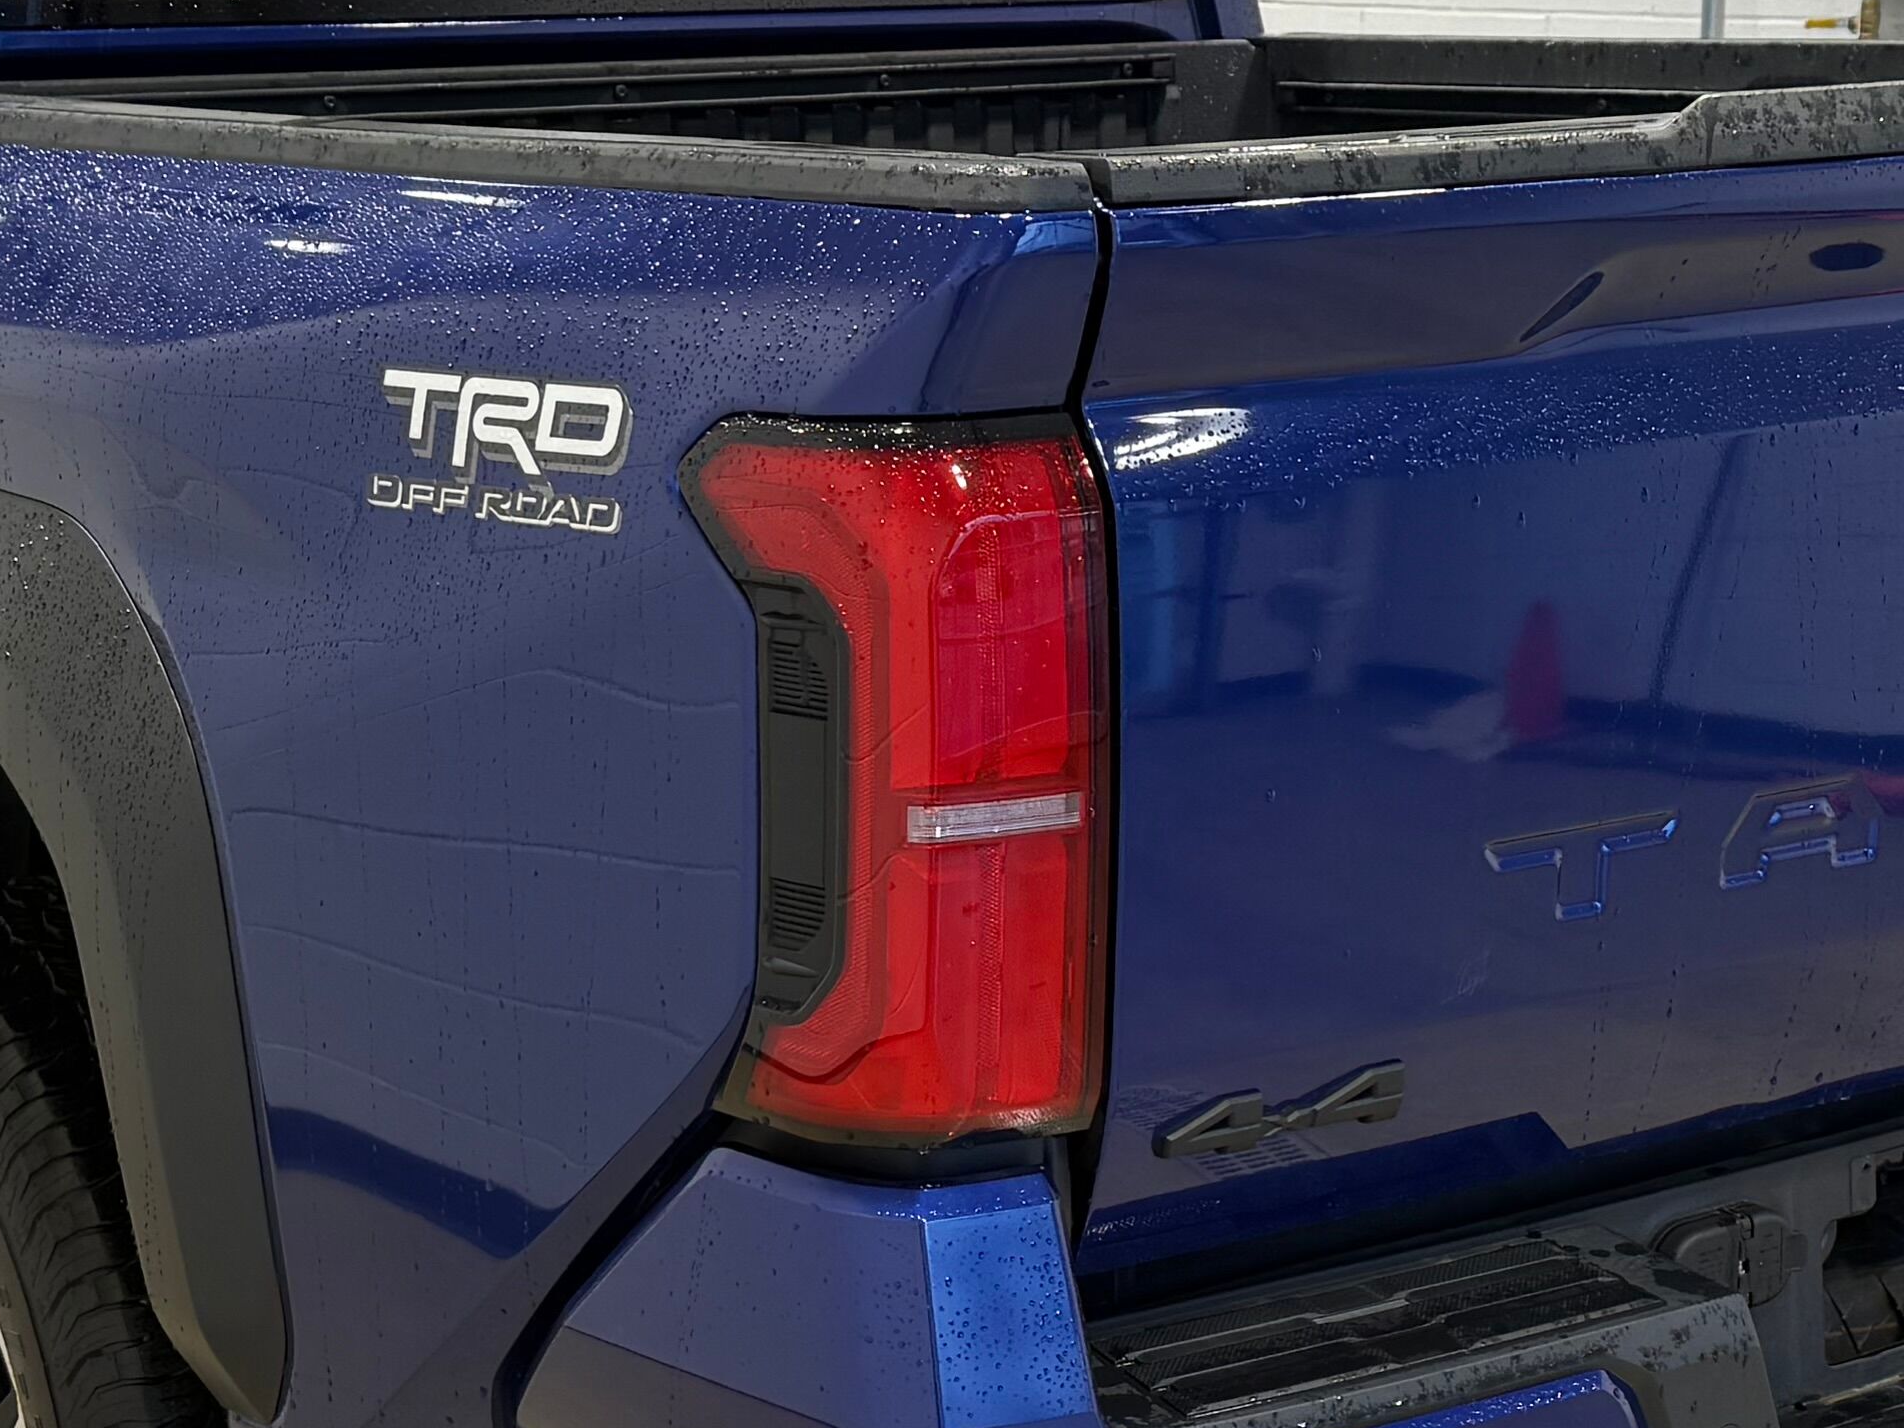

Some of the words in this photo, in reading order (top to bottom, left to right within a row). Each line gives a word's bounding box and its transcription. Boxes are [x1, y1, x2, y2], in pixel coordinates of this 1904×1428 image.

[382, 368, 630, 478] TRD
[366, 473, 469, 515] OFF
[474, 489, 623, 536] ROAD
